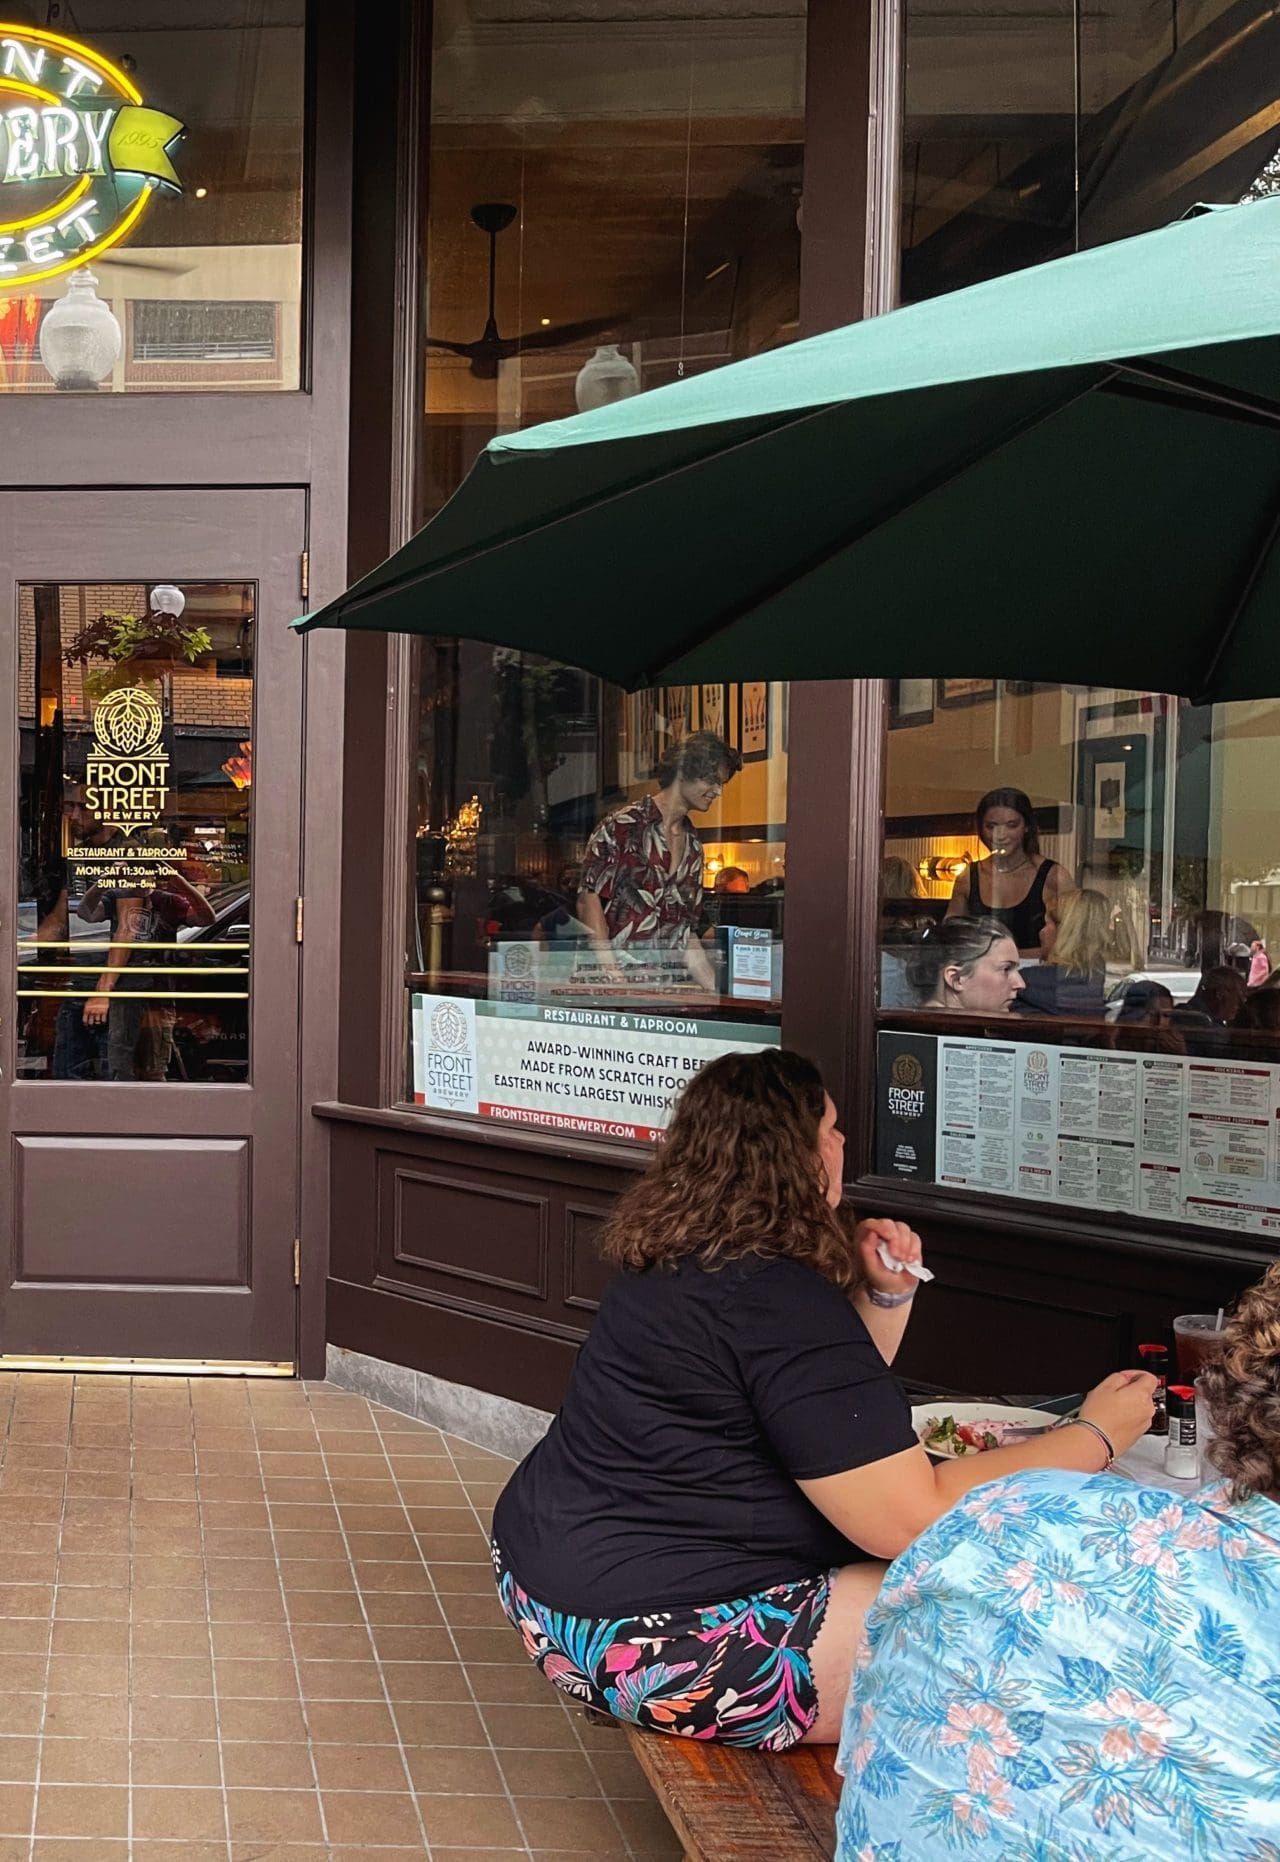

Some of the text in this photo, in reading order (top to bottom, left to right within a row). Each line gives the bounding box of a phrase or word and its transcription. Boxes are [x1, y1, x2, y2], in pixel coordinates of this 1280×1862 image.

[86, 763, 170, 786] FRONT
[85, 787, 170, 810] STREET
[94, 811, 161, 820] BREWERY
[67, 848, 187, 857] RESTAURANT & TAPROOM
[75, 866, 120, 875] MON-SAT
[97, 879, 116, 888] SUN
[544, 1009, 698, 1034] RESTAURANT & TAPROOM
[427, 1053, 472, 1073] FRONT
[527, 1041, 634, 1064] AWARD-WINNING
[638, 1053, 678, 1069] CRAFT
[427, 1071, 473, 1091] STREET
[521, 1059, 688, 1090] MADE FROM SCRATCH FOO
[433, 1088, 469, 1098] BREWERY
[494, 1074, 673, 1109] EASTERN NC'S LARGEST WHISK
[888, 1087, 925, 1101] FRONT
[888, 1098, 925, 1113] STREET
[490, 1106, 636, 1138] FRONTSTREETBREWERY.COM
